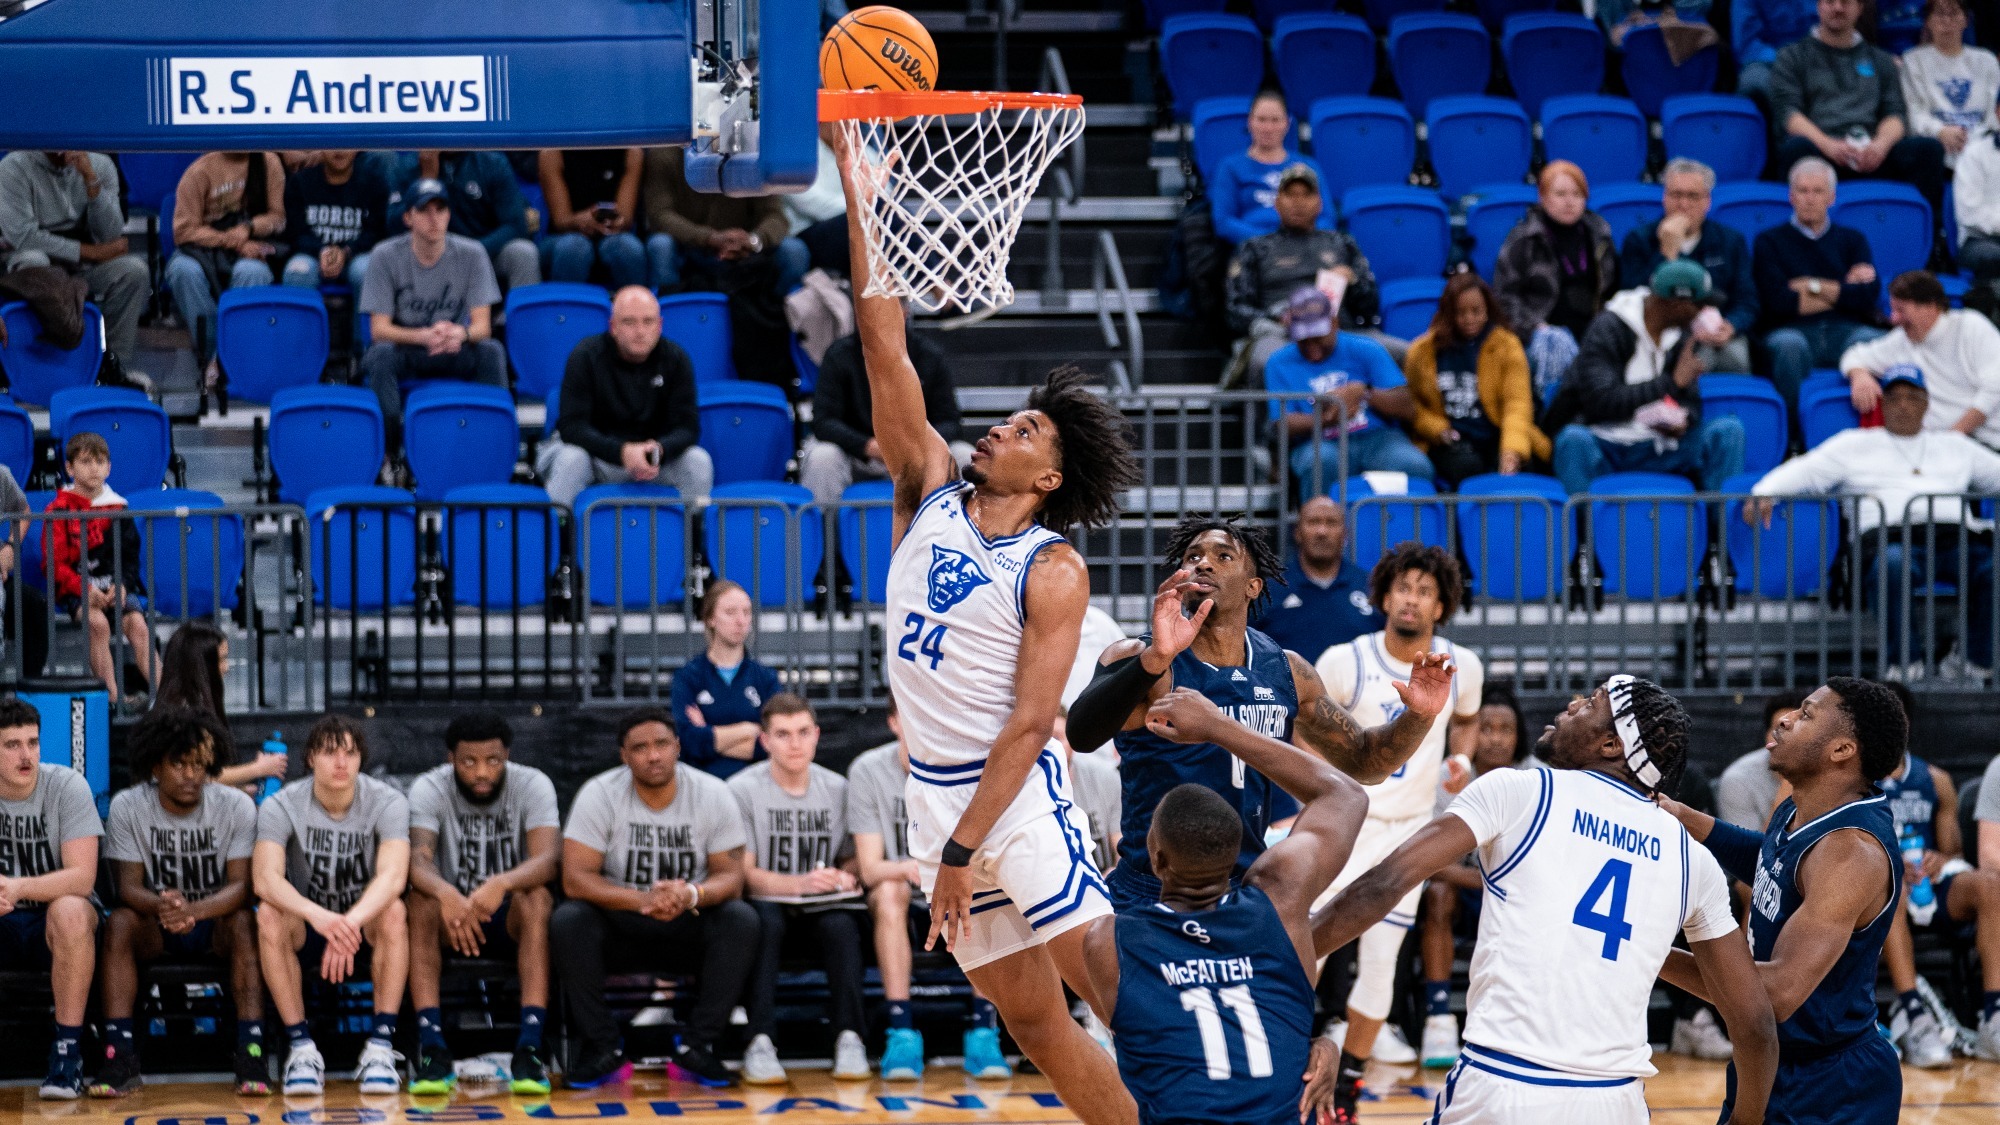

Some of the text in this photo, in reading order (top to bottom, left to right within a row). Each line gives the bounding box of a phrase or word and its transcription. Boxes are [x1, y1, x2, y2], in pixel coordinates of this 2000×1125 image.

[881, 37, 931, 91] Wilson
[179, 69, 480, 114] R.S. Andrews
[994, 552, 1021, 573] SBC
[898, 612, 948, 671] 24
[15, 814, 48, 840] GAME
[150, 826, 217, 851] THIS GAME
[306, 826, 334, 852] THIS
[630, 822, 691, 849] THIS GAME
[768, 809, 830, 833] THIS GAME
[1572, 808, 1660, 861] NNAMOKO
[0, 839, 56, 877] S NO
[151, 852, 222, 890] IS NO
[335, 852, 371, 891] NO
[624, 850, 697, 884] IS NO
[769, 835, 834, 873] IS NO
[1572, 858, 1632, 961] 4
[1160, 956, 1253, 986] McFATTEN
[1180, 984, 1273, 1080] 11
